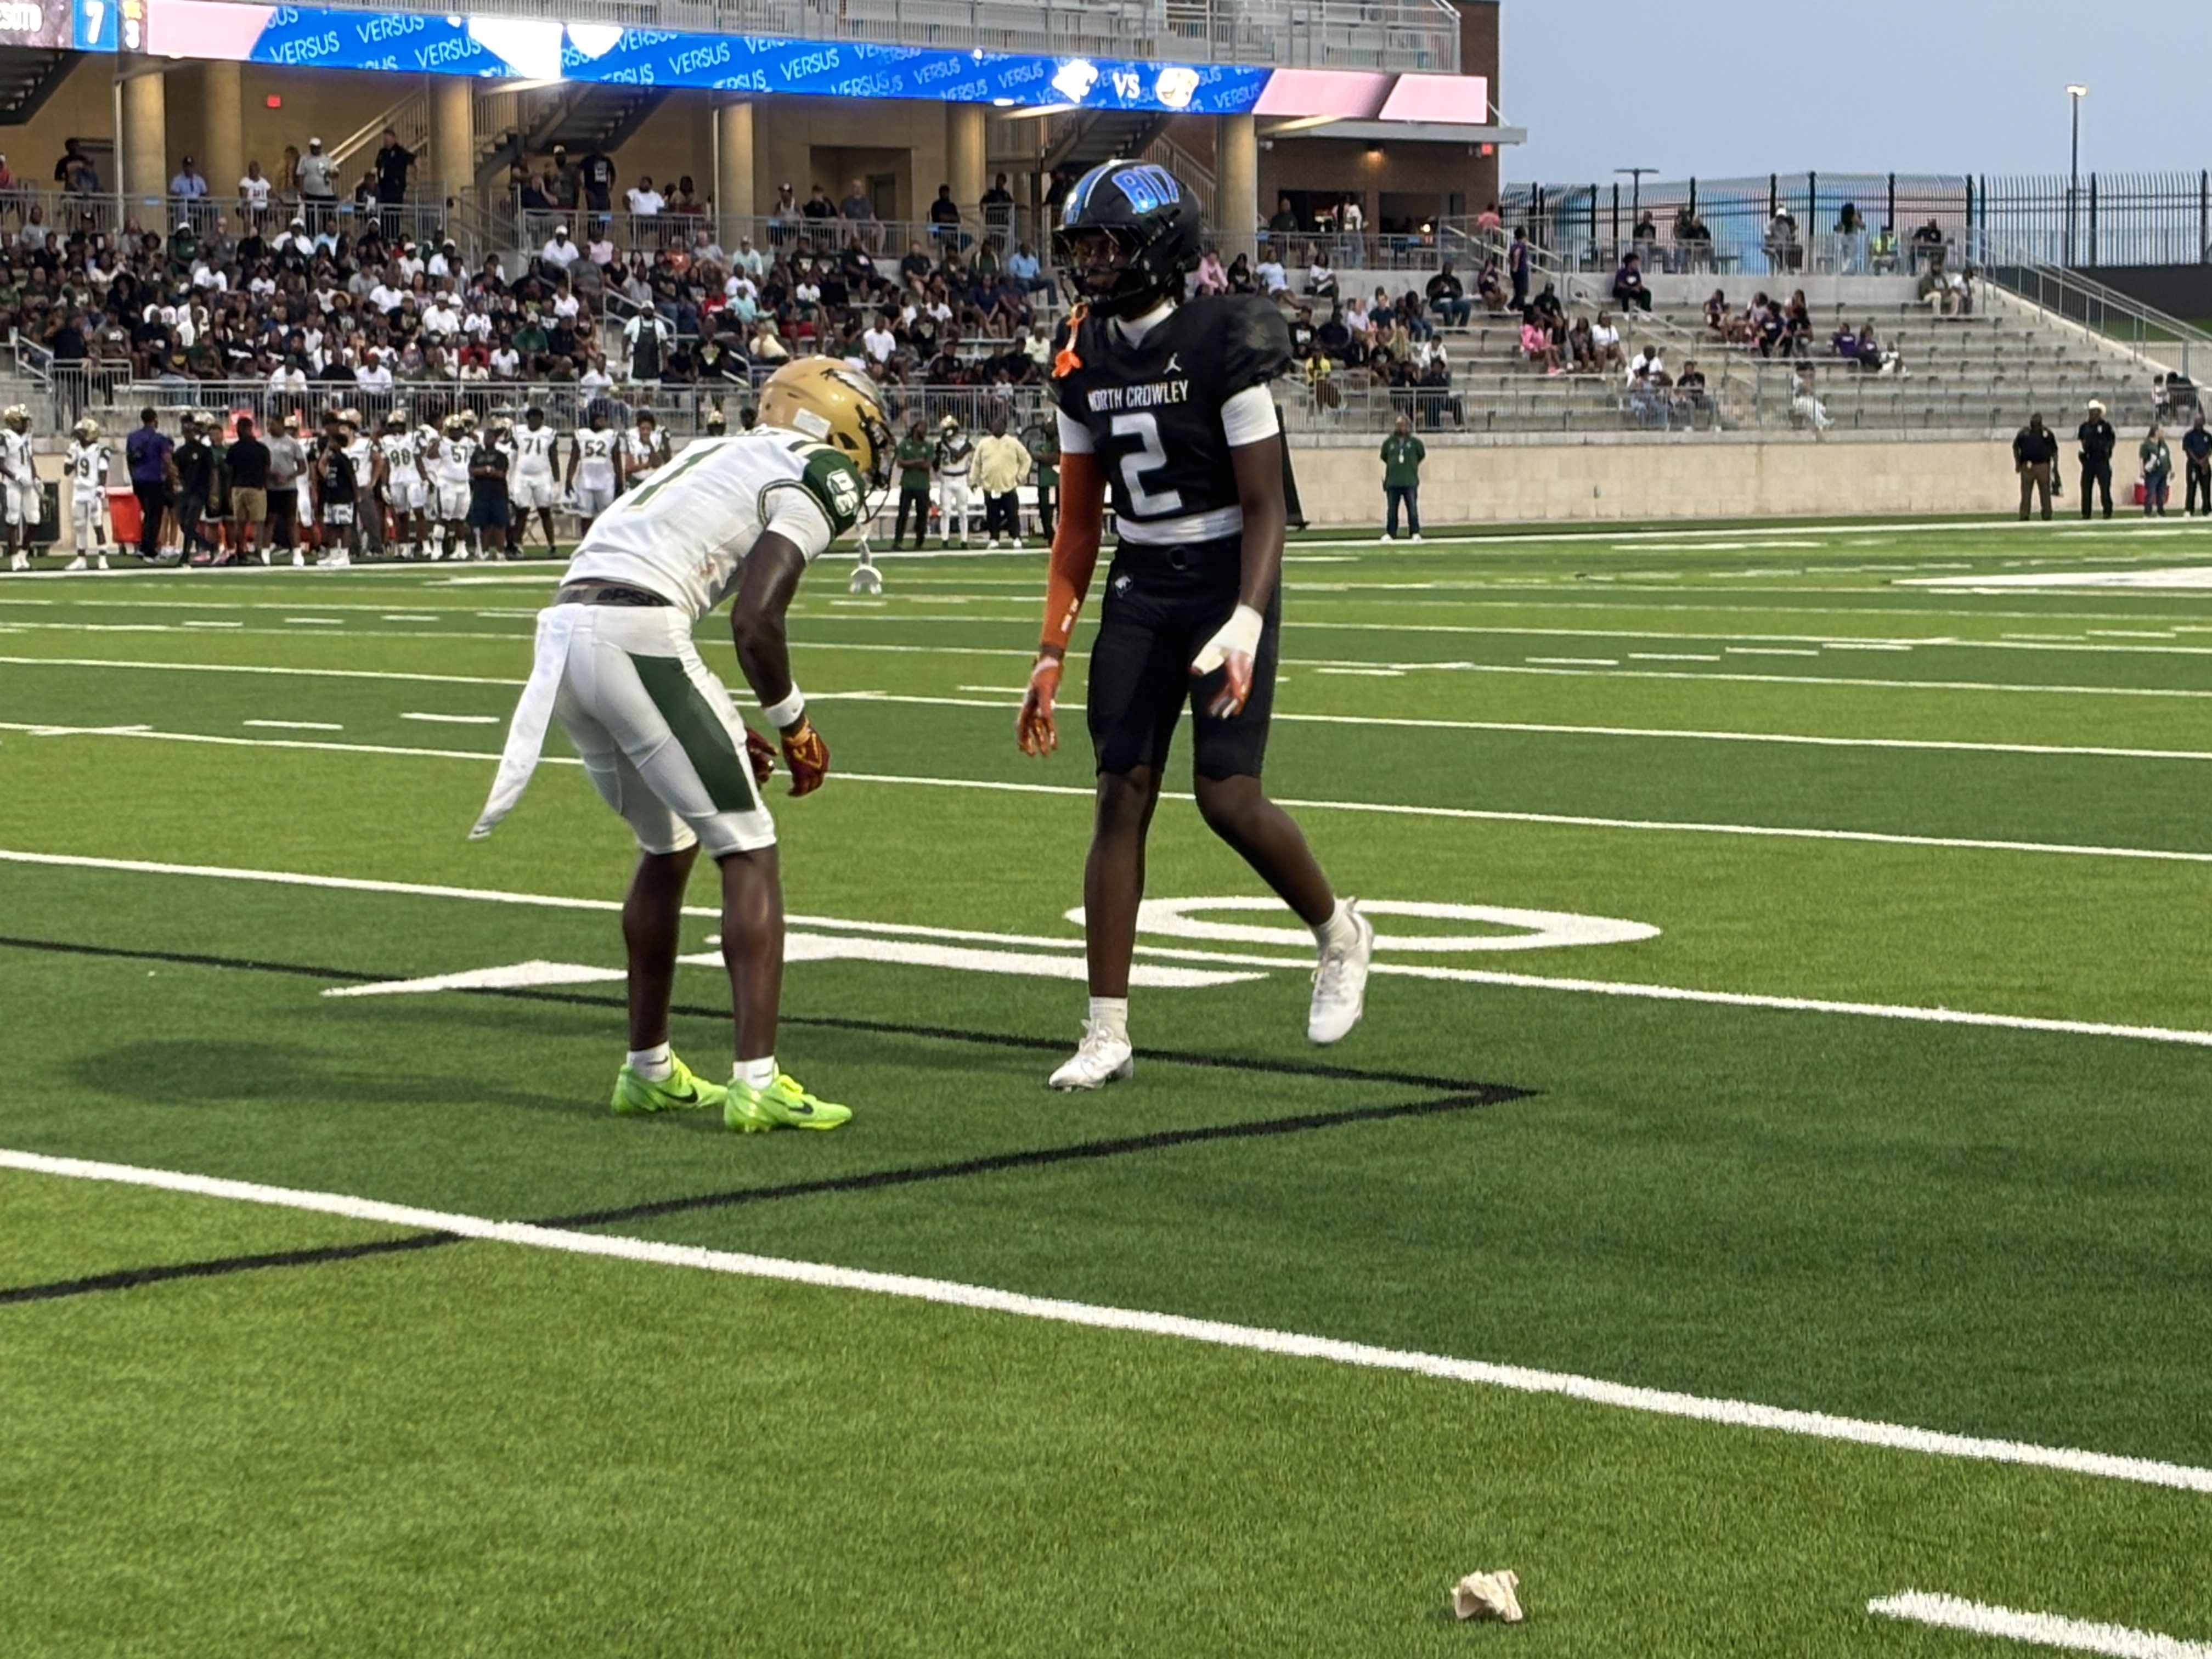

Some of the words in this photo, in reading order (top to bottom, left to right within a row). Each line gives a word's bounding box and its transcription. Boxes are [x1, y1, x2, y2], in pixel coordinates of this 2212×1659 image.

[86, 1, 104, 44] 7
[356, 14, 424, 43] VERSUS
[269, 30, 340, 65] VERSUS
[669, 41, 730, 75] VERSUS
[780, 48, 839, 81] VERSUS
[913, 57, 961, 85] VERSUS
[997, 61, 1044, 88] VERSUS
[1113, 72, 1141, 99] VS
[1088, 387, 1123, 412] NORTH
[1126, 379, 1189, 408] CROWLEY
[524, 437, 541, 455] 71
[585, 439, 606, 457] 52
[1111, 412, 1183, 517] 2
